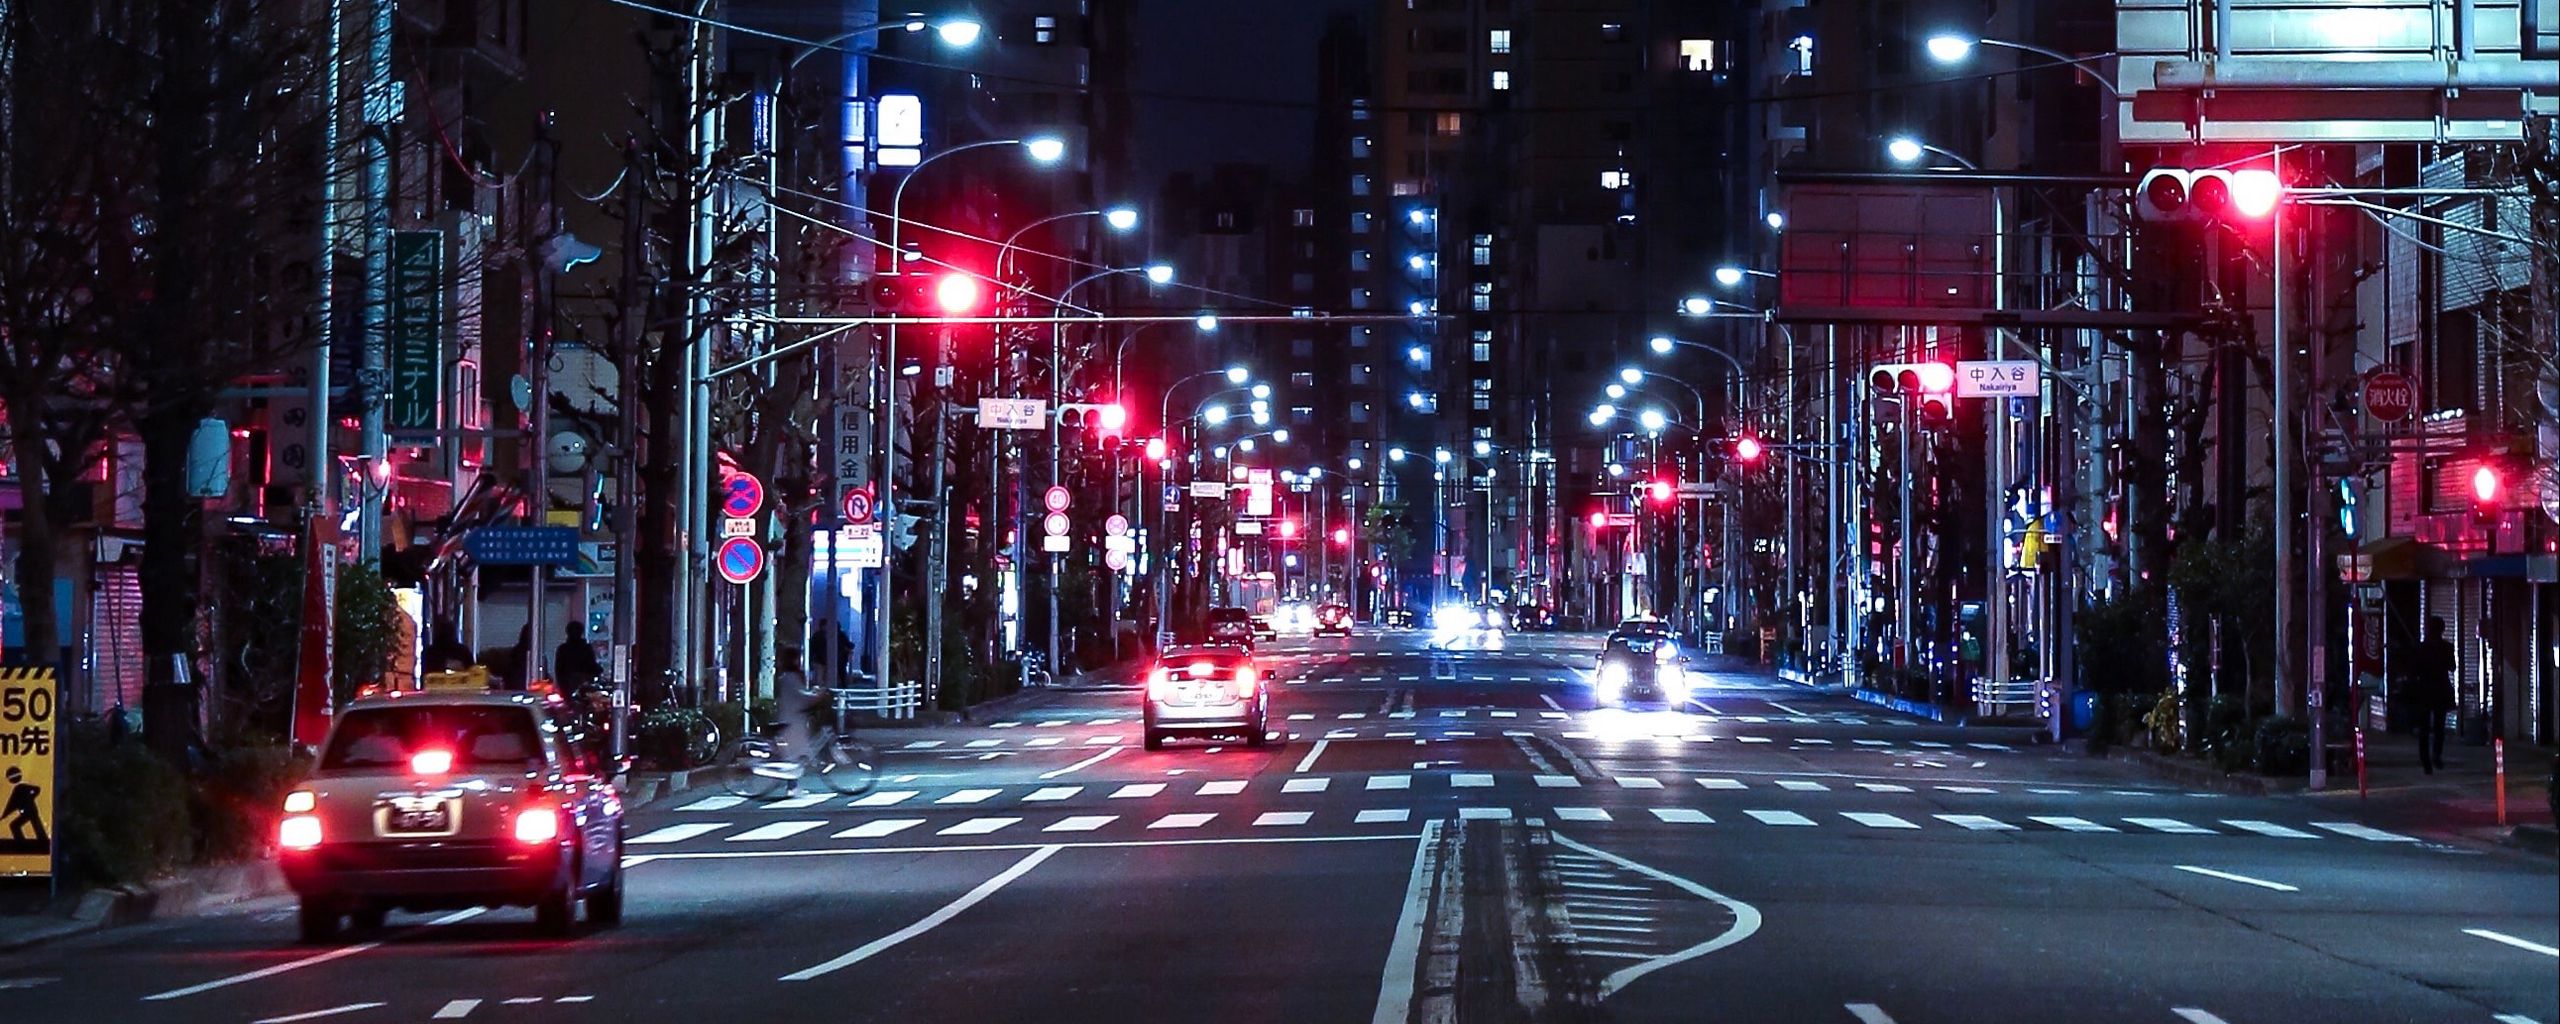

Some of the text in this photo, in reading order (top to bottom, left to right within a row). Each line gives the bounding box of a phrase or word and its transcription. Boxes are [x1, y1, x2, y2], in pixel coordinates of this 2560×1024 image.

[1970, 367, 2025, 382] 中入谷
[1980, 383, 2017, 392] Nakairiya
[2369, 388, 2409, 407] 消火栓
[990, 403, 1035, 417] 中入谷
[3, 687, 52, 722] 50
